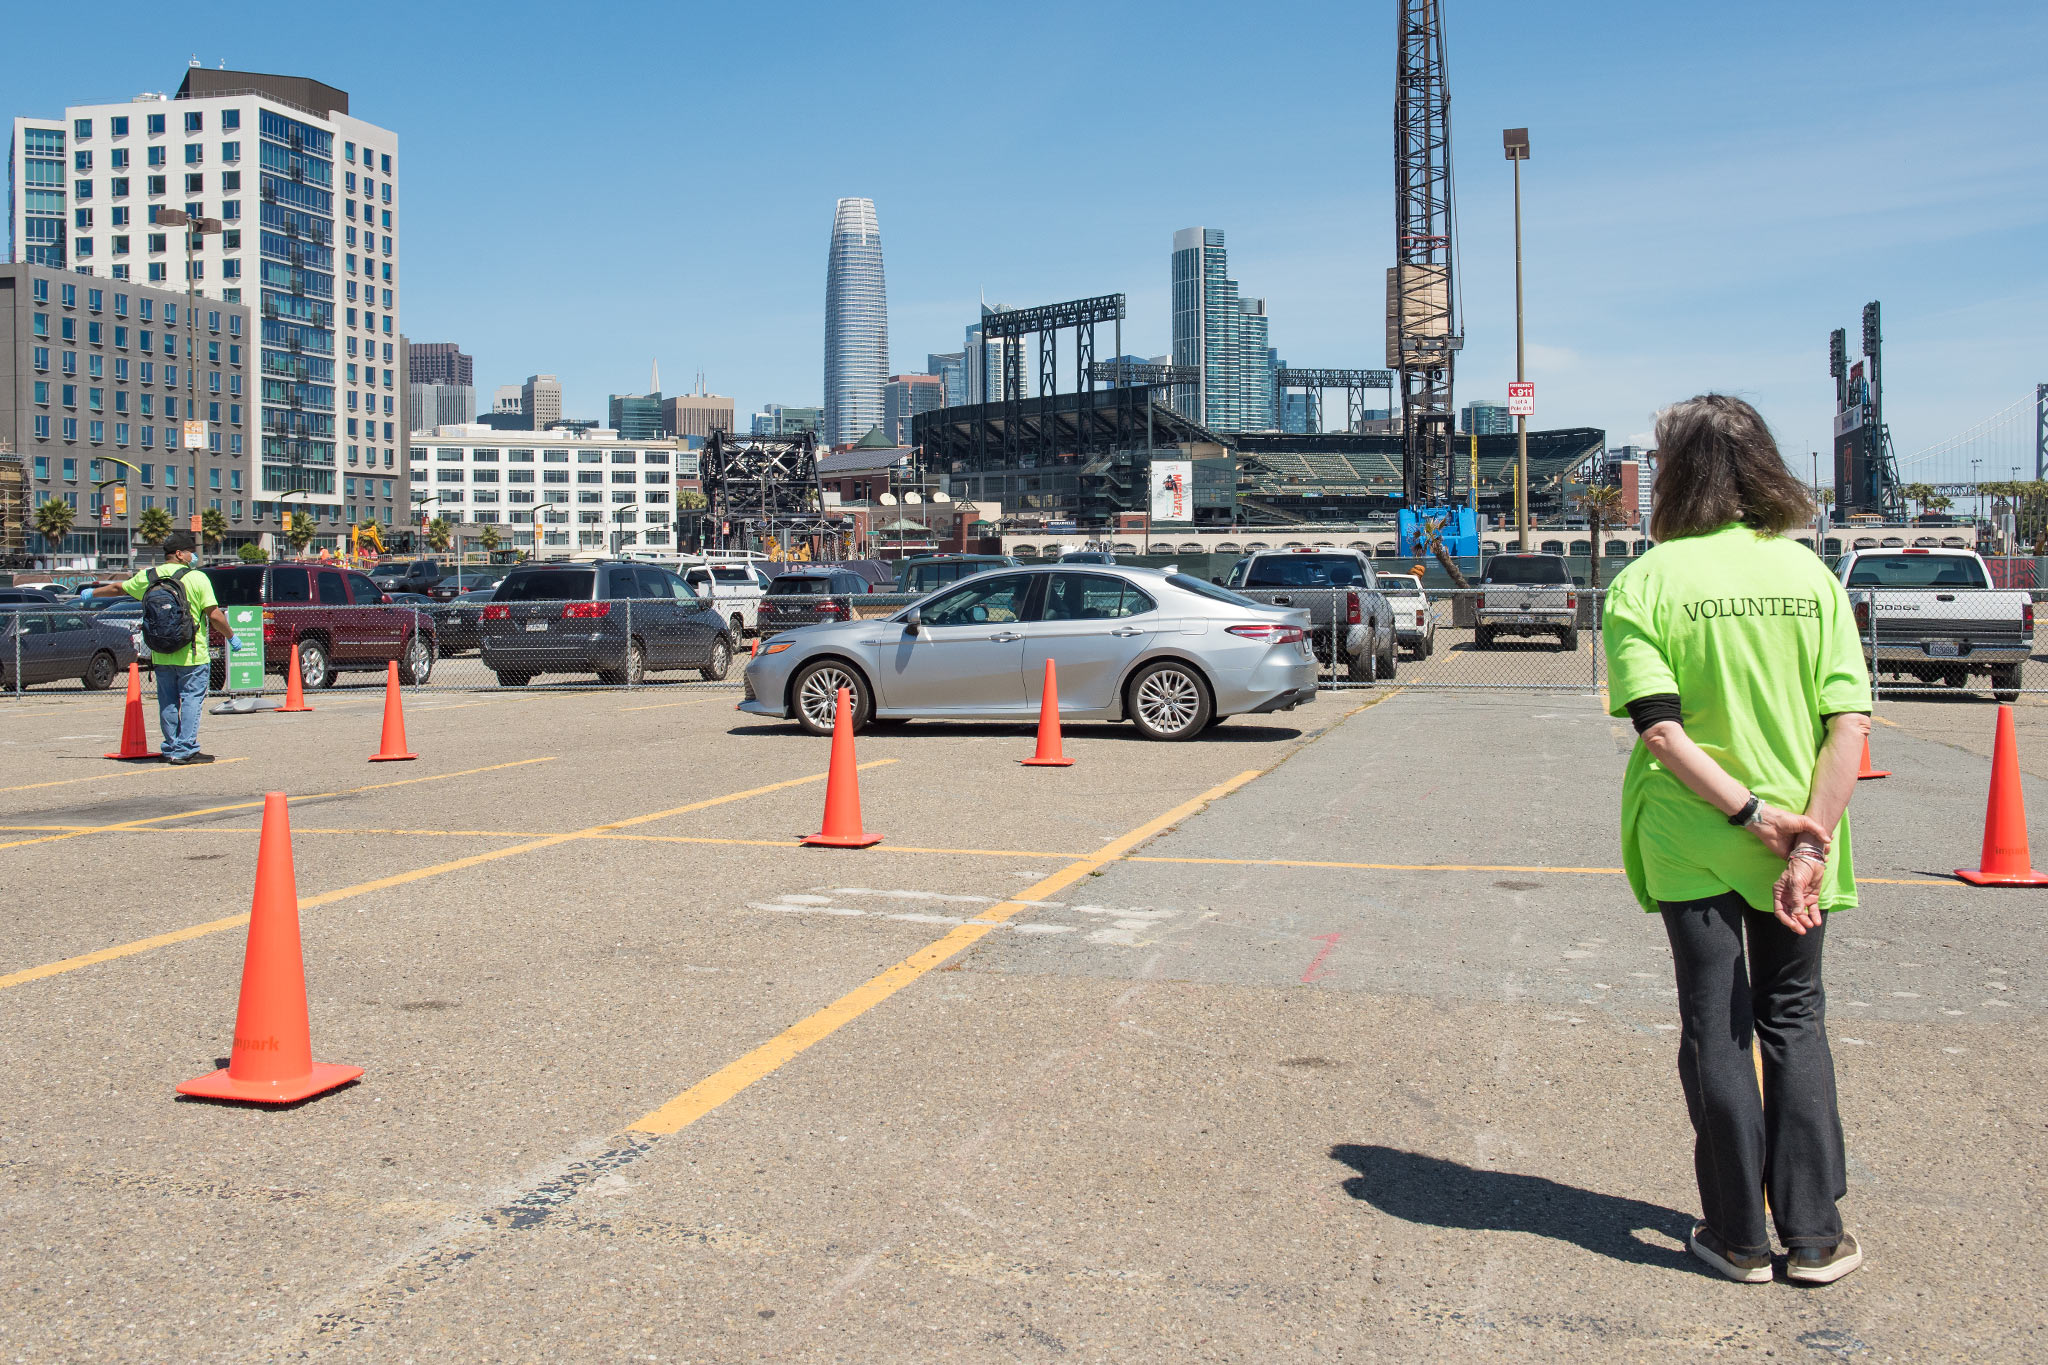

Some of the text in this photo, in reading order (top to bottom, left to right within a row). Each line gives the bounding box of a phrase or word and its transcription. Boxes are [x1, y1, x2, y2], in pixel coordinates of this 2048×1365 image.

[1517, 389, 1533, 397] 911
[1683, 598, 1820, 622] VOLUNTEER
[233, 1036, 279, 1051] mpark
